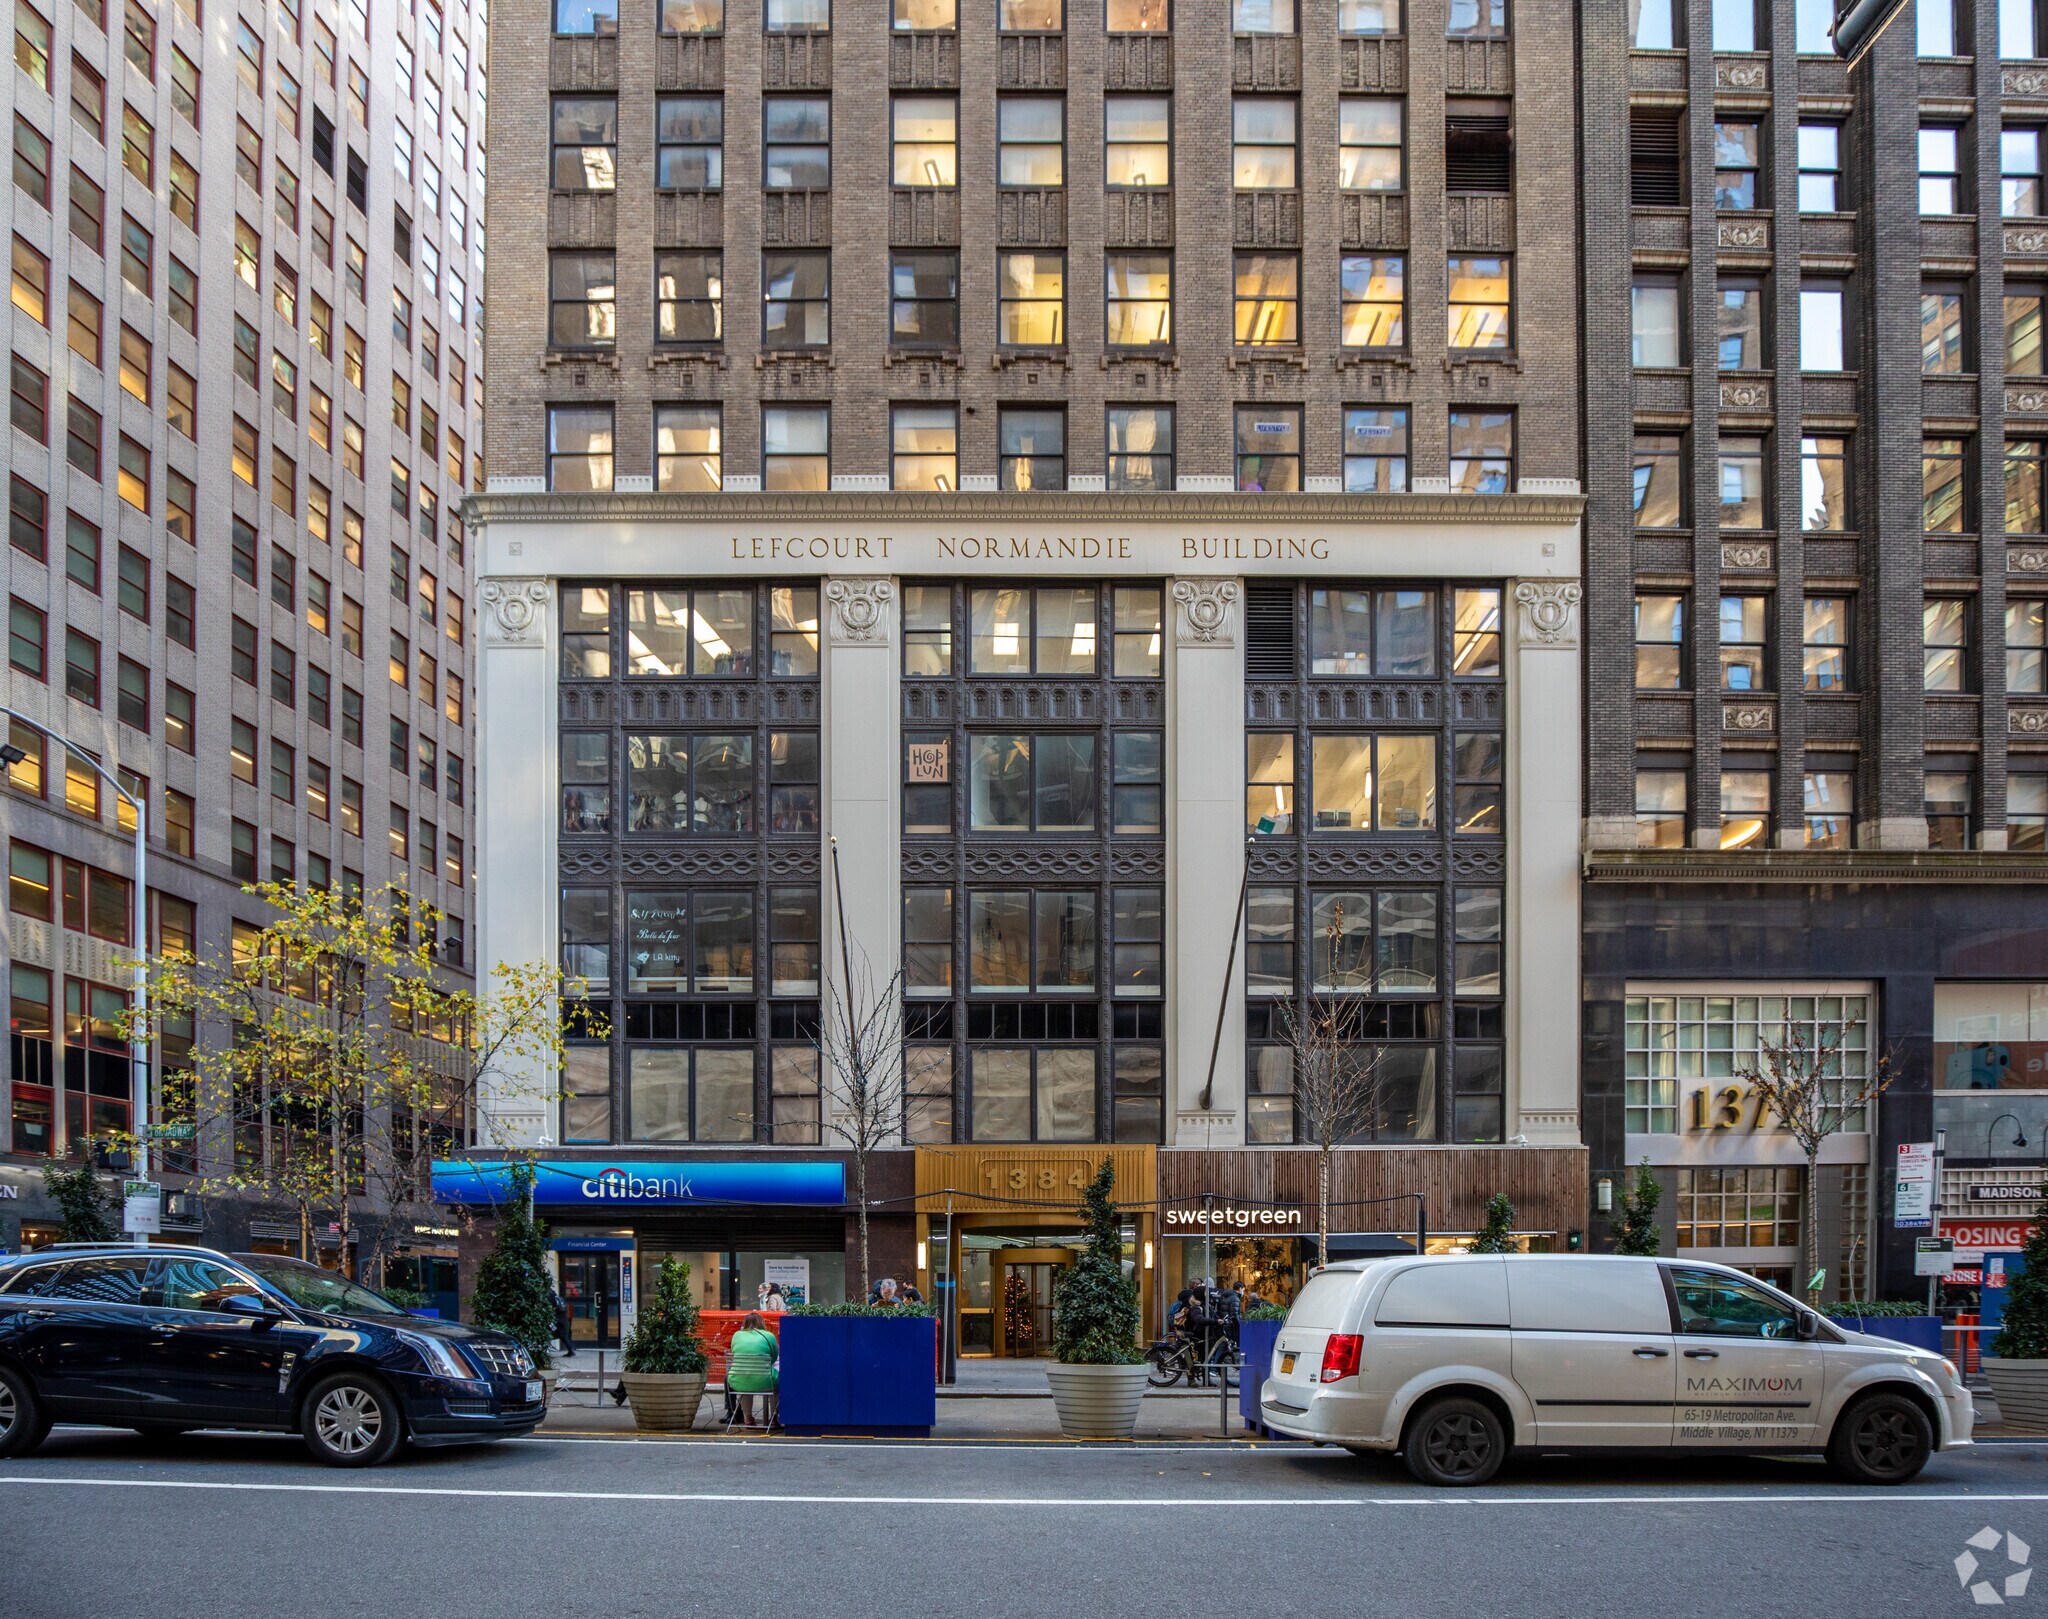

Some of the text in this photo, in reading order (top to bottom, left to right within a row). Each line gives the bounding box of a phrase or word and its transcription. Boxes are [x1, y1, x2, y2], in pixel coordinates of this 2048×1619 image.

[731, 537, 1329, 560] LEFCOURT NORMANDIE BUILDING
[913, 748, 944, 767] HOP
[916, 764, 944, 778] LUN
[653, 953, 680, 963] LA kitty
[582, 1170, 693, 1198] citibank
[985, 1168, 1087, 1189] 1384
[1979, 1187, 2042, 1198] MADISON
[1166, 1207, 1301, 1228] sweetgreen
[1687, 1377, 1803, 1391] MAXIMUM
[1684, 1409, 1796, 1423] 65-19 Metropolitan Ave.
[1680, 1426, 1798, 1441] Middle Village, NY 11379
